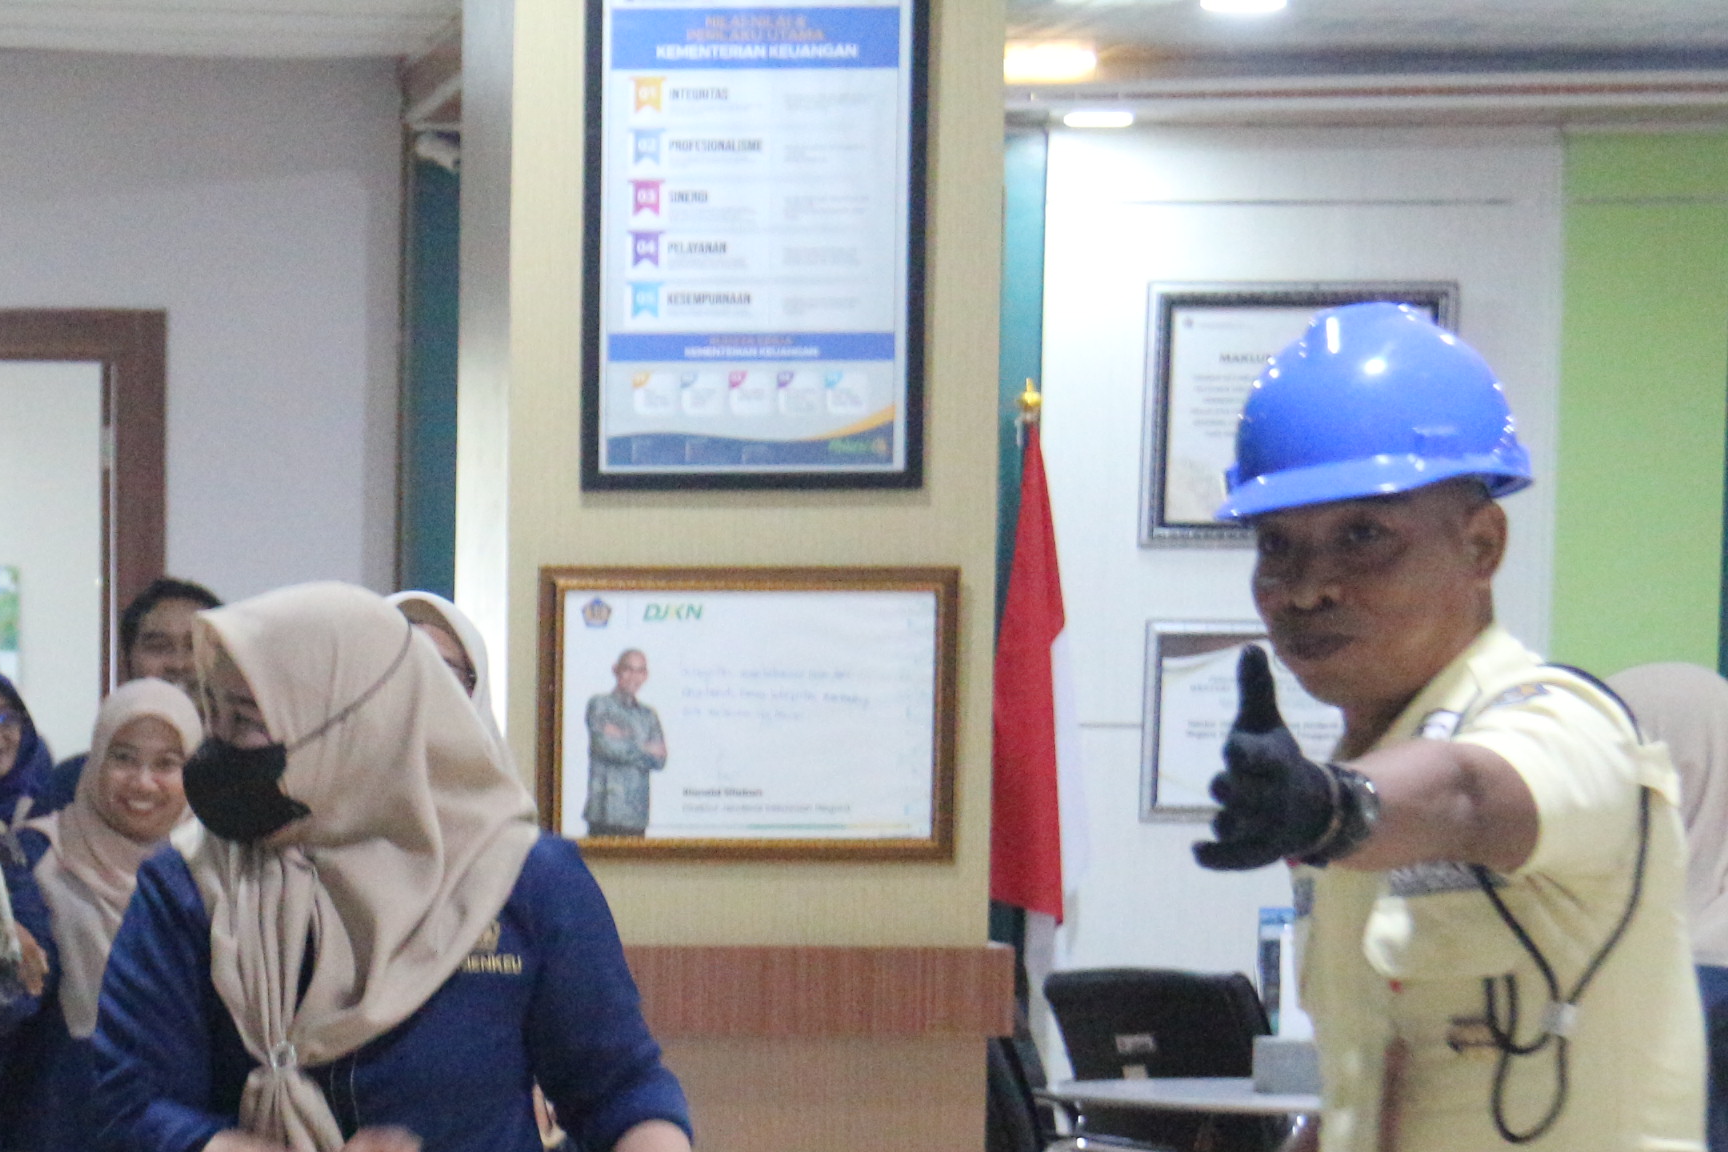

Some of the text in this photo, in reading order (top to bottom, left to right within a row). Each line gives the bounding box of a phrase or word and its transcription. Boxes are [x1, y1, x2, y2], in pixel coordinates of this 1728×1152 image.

[655, 43, 858, 59] KEMENTERIAN KEUANGAN
[669, 87, 729, 101] INTEGRITAS
[669, 138, 762, 152] PROFESIONALISME
[667, 241, 727, 254] PELAYANAN
[667, 291, 751, 305] KESEMPURNAAN
[643, 603, 703, 621] DJKN
